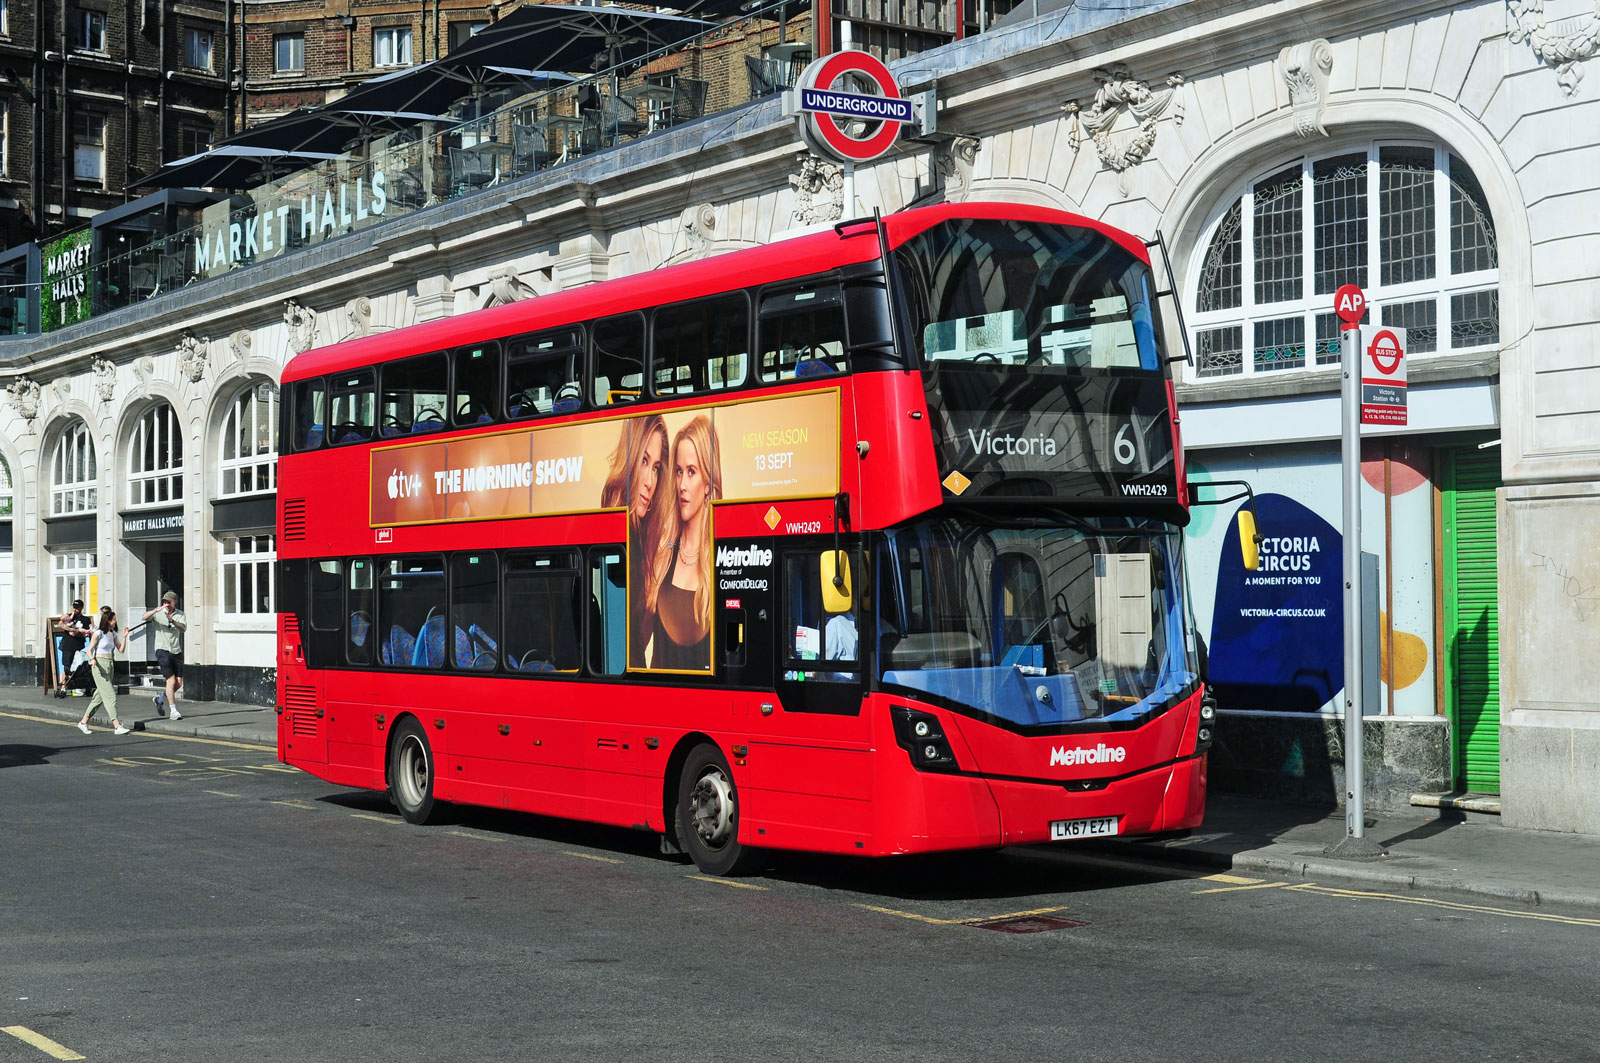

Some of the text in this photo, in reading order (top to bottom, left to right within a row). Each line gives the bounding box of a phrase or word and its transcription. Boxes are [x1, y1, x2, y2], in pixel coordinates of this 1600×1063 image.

[806, 93, 907, 117] UNDERGROUND
[195, 171, 386, 274] MARKET HALLS
[48, 244, 91, 276] MARKET
[53, 273, 85, 301] HALLS
[1339, 294, 1363, 312] AP
[742, 428, 808, 449] NEW SEASON
[968, 423, 1136, 465] Victoria 6
[754, 452, 794, 472] 13 SEPT
[434, 456, 583, 495] THE MORNING SHOW
[1121, 484, 1168, 496] VWH2429
[124, 519, 146, 532] MARKET
[147, 517, 165, 530] HALLS
[785, 521, 821, 534] VWH2429
[1257, 536, 1320, 553] CTORIA
[716, 544, 773, 567] Metroline
[1252, 577, 1286, 585] MOMENT
[1287, 577, 1303, 585] FOR
[1304, 576, 1321, 585] YOU
[1240, 608, 1326, 617] VICTORIA-CIRCUS.CO.UK
[1049, 743, 1126, 767] Metroline
[1056, 818, 1113, 837] LK67 EZT
